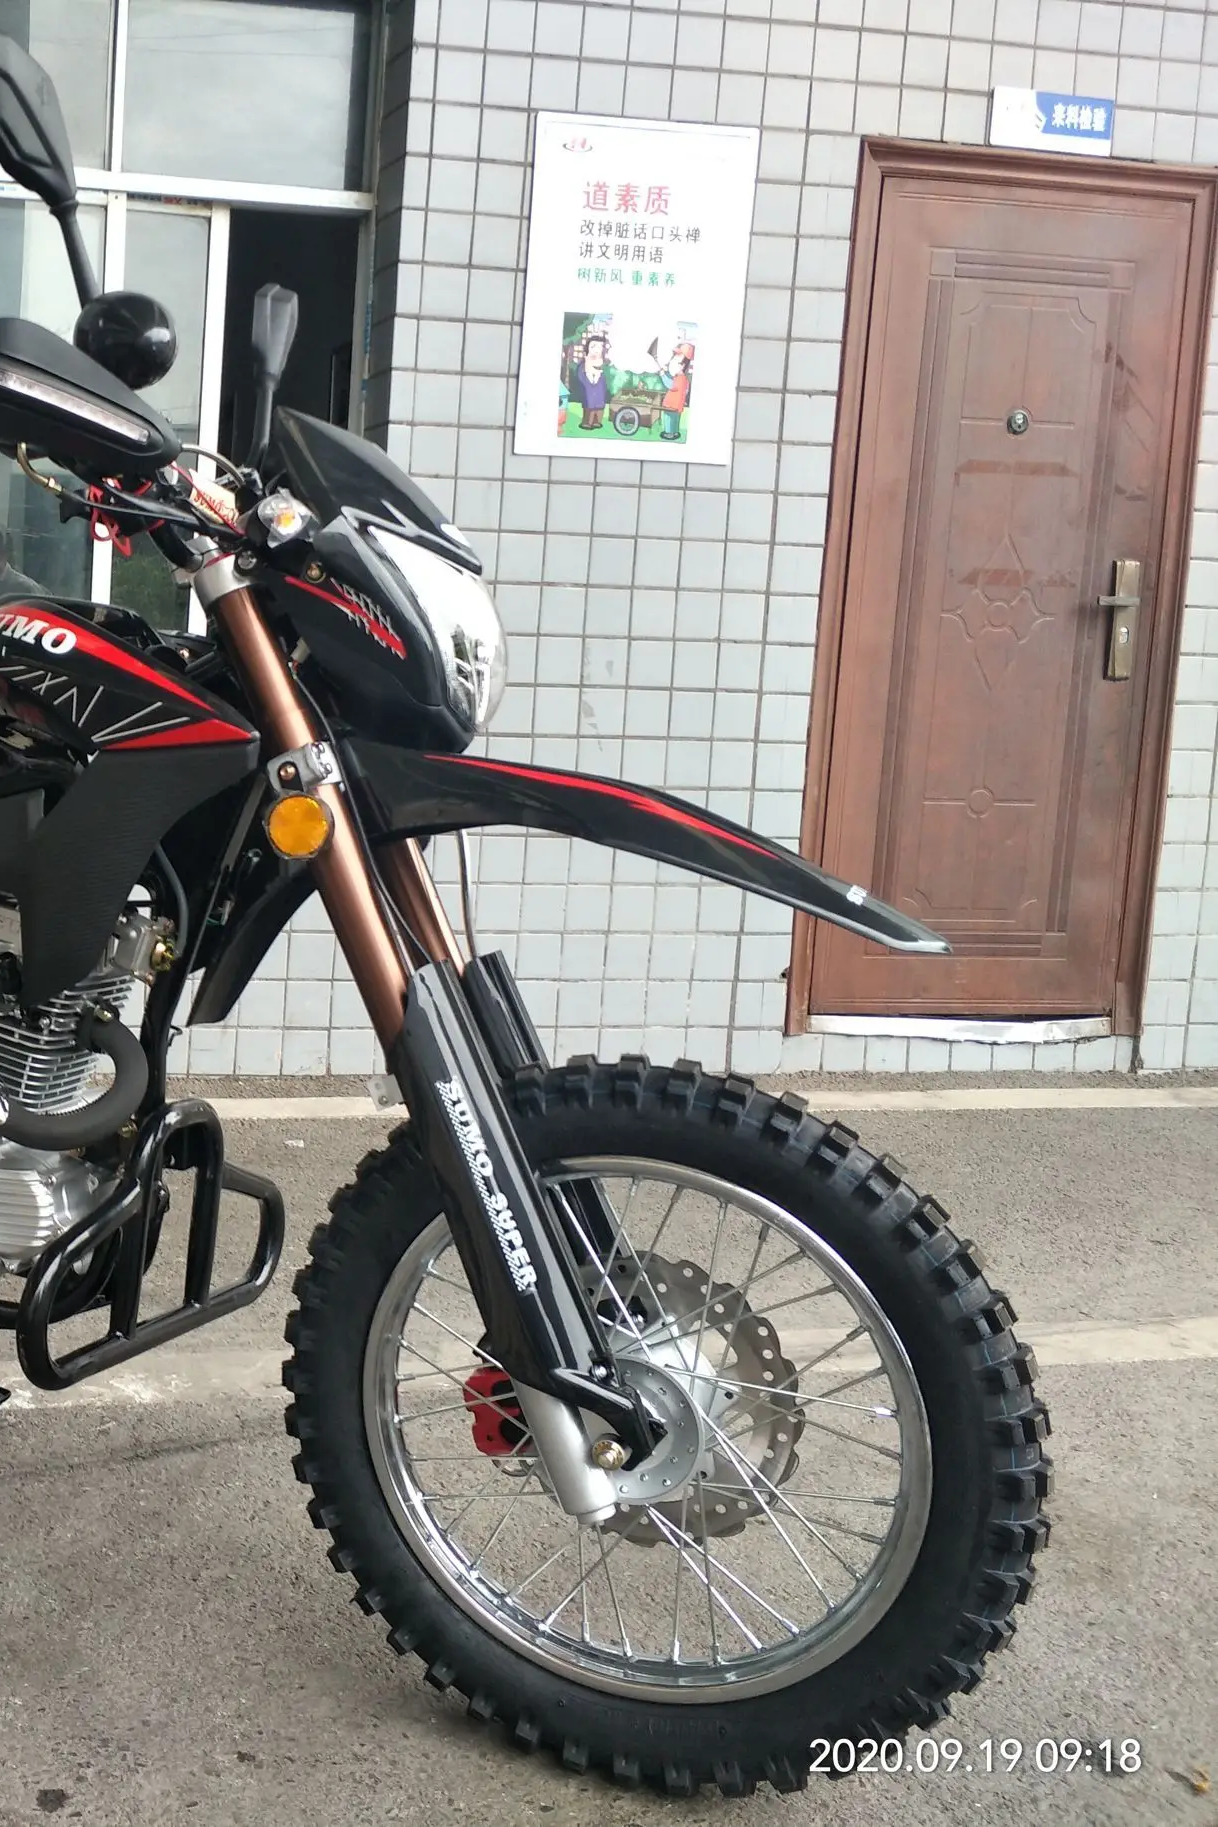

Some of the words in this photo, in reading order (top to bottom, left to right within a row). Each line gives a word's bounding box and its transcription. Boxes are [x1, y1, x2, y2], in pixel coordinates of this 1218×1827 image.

[579, 219, 701, 244] 改掉脏话口头禅
[579, 241, 664, 264] 讲文明用语
[442, 1074, 494, 1178] SUMO
[488, 1191, 539, 1290] SUPER
